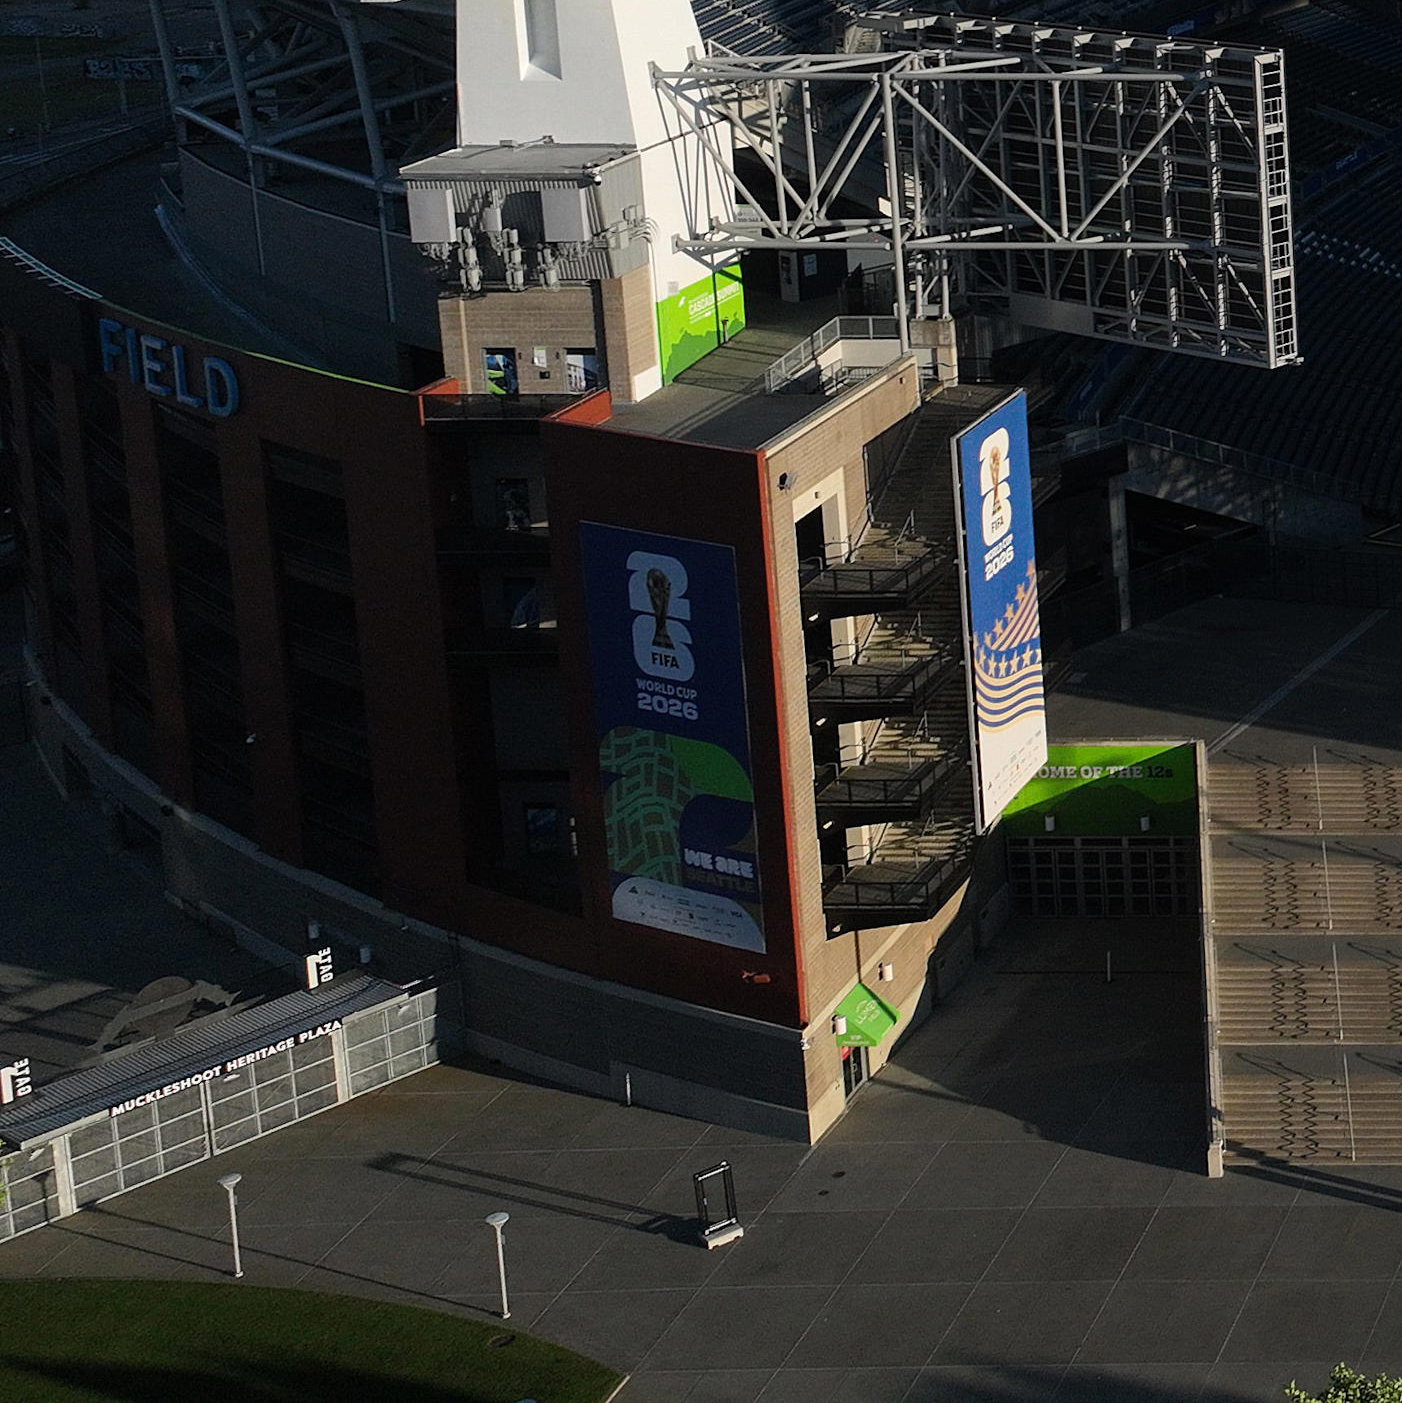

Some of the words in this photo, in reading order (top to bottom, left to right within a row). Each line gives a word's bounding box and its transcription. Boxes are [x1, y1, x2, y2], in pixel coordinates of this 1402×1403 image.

[99, 318, 240, 418] FIELD
[991, 516, 1004, 534] FIFA
[984, 545, 1014, 582] 2026
[652, 652, 679, 669] FIFA
[636, 677, 675, 697] WORLD
[675, 685, 697, 699] CUP
[637, 692, 699, 721] 2026
[1080, 765, 1101, 779] OF
[1108, 765, 1144, 779] THE
[684, 848, 714, 870] WE
[110, 1065, 223, 1118] MUCKLESHOOT
[226, 1037, 295, 1073] HERITAGE
[299, 1020, 343, 1045] PLAZA
